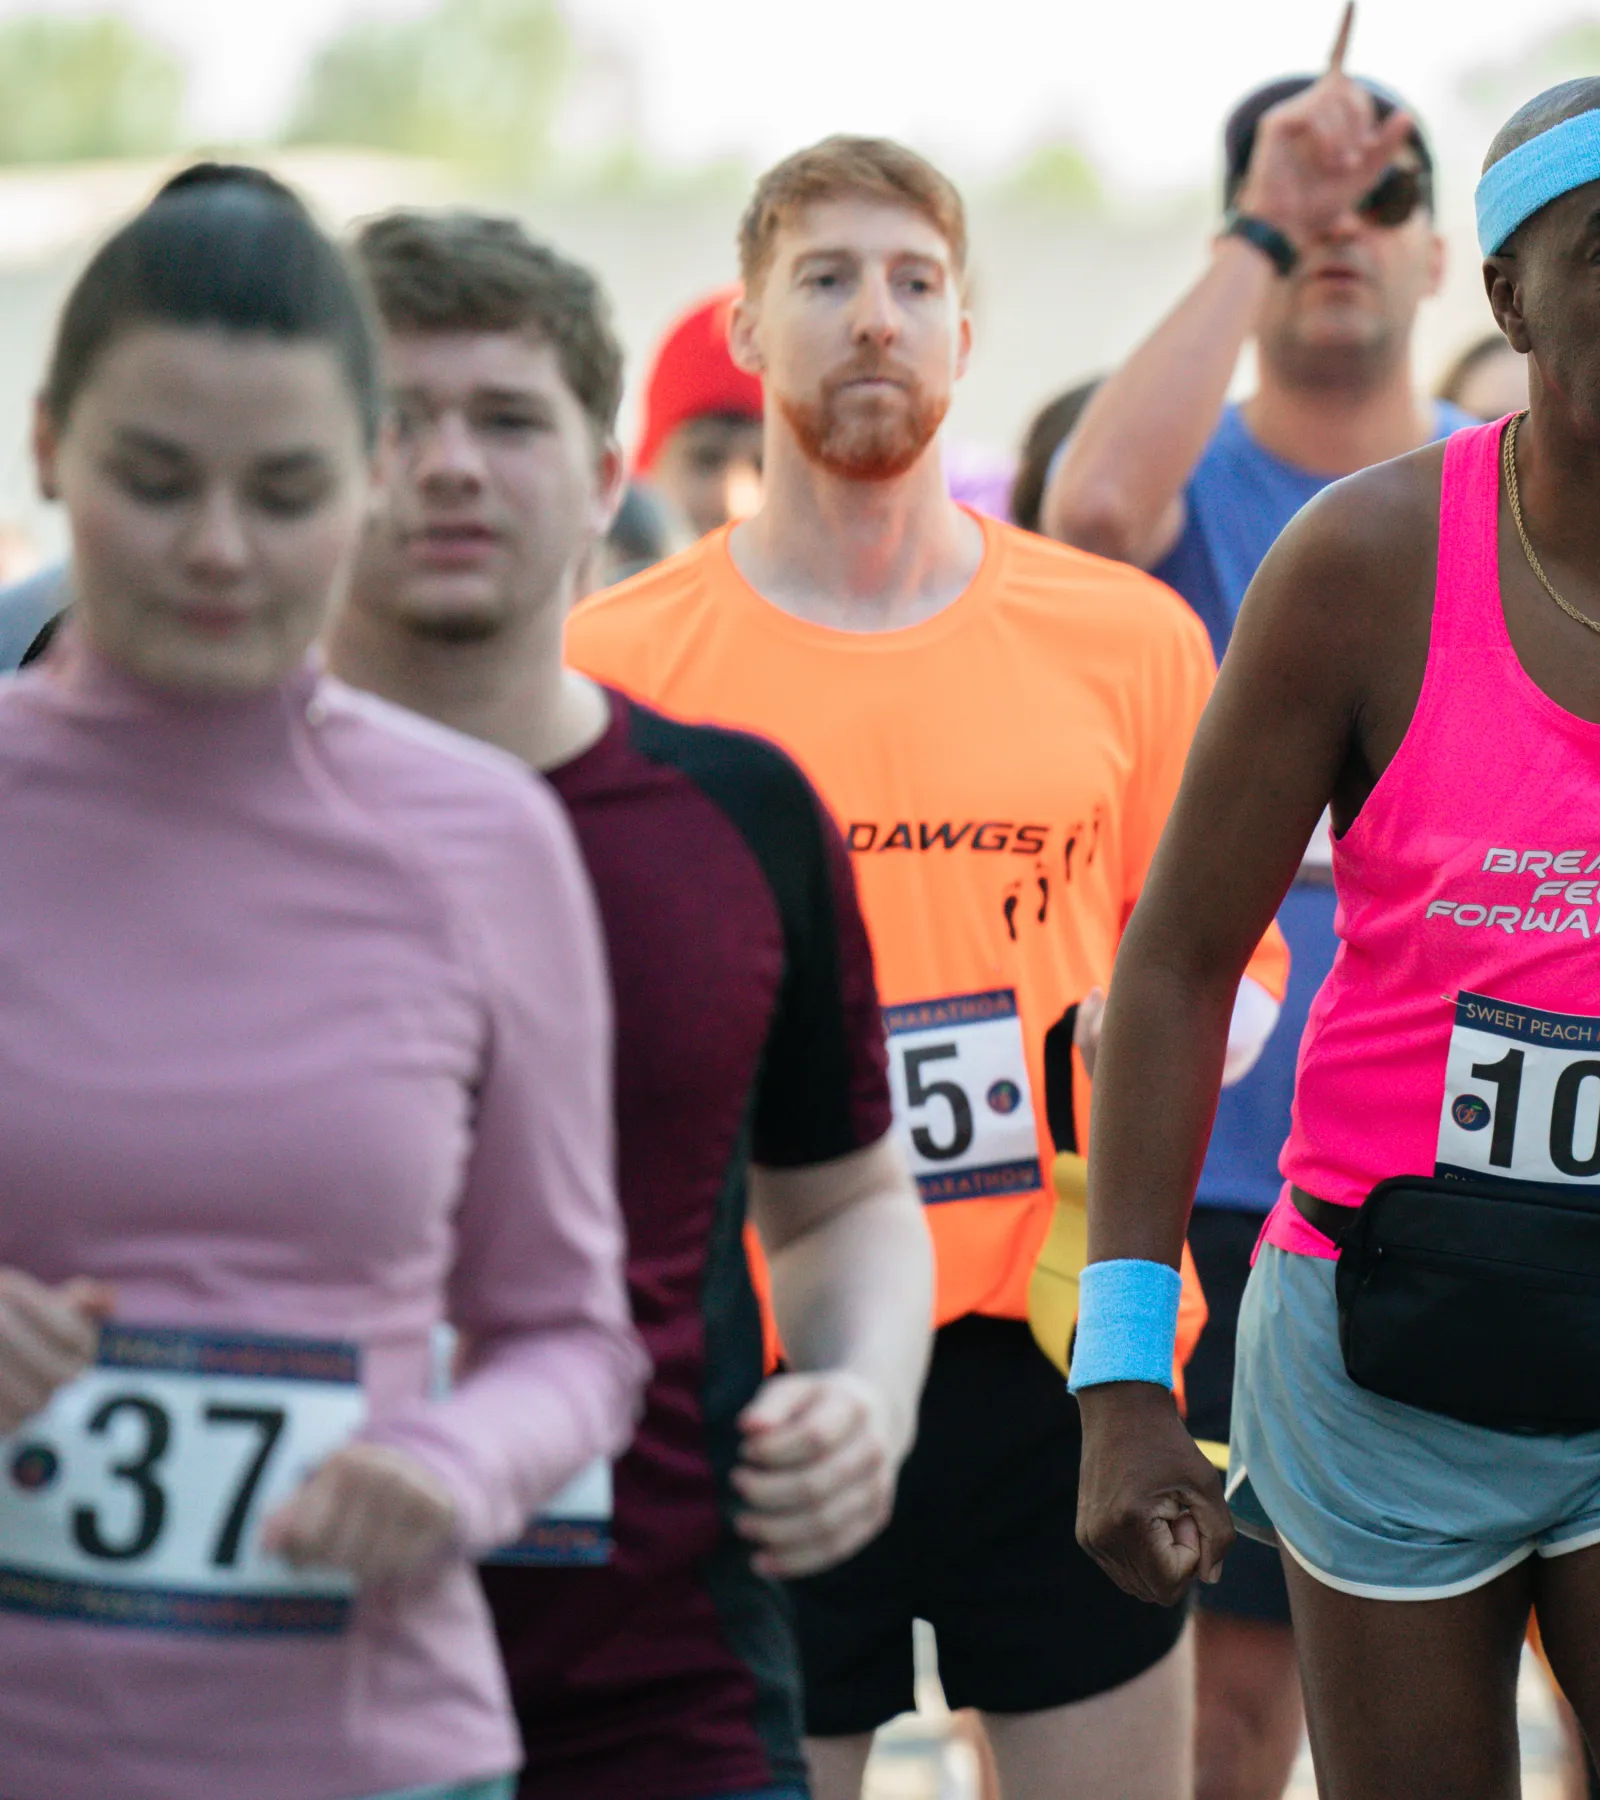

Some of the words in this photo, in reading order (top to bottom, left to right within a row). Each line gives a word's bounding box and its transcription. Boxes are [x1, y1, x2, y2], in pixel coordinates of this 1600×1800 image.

[847, 821, 1050, 854] DAWGS
[1466, 1003, 1526, 1031] SWEET
[1530, 1019, 1592, 1042] PEACH
[70, 1394, 288, 1568] 37
